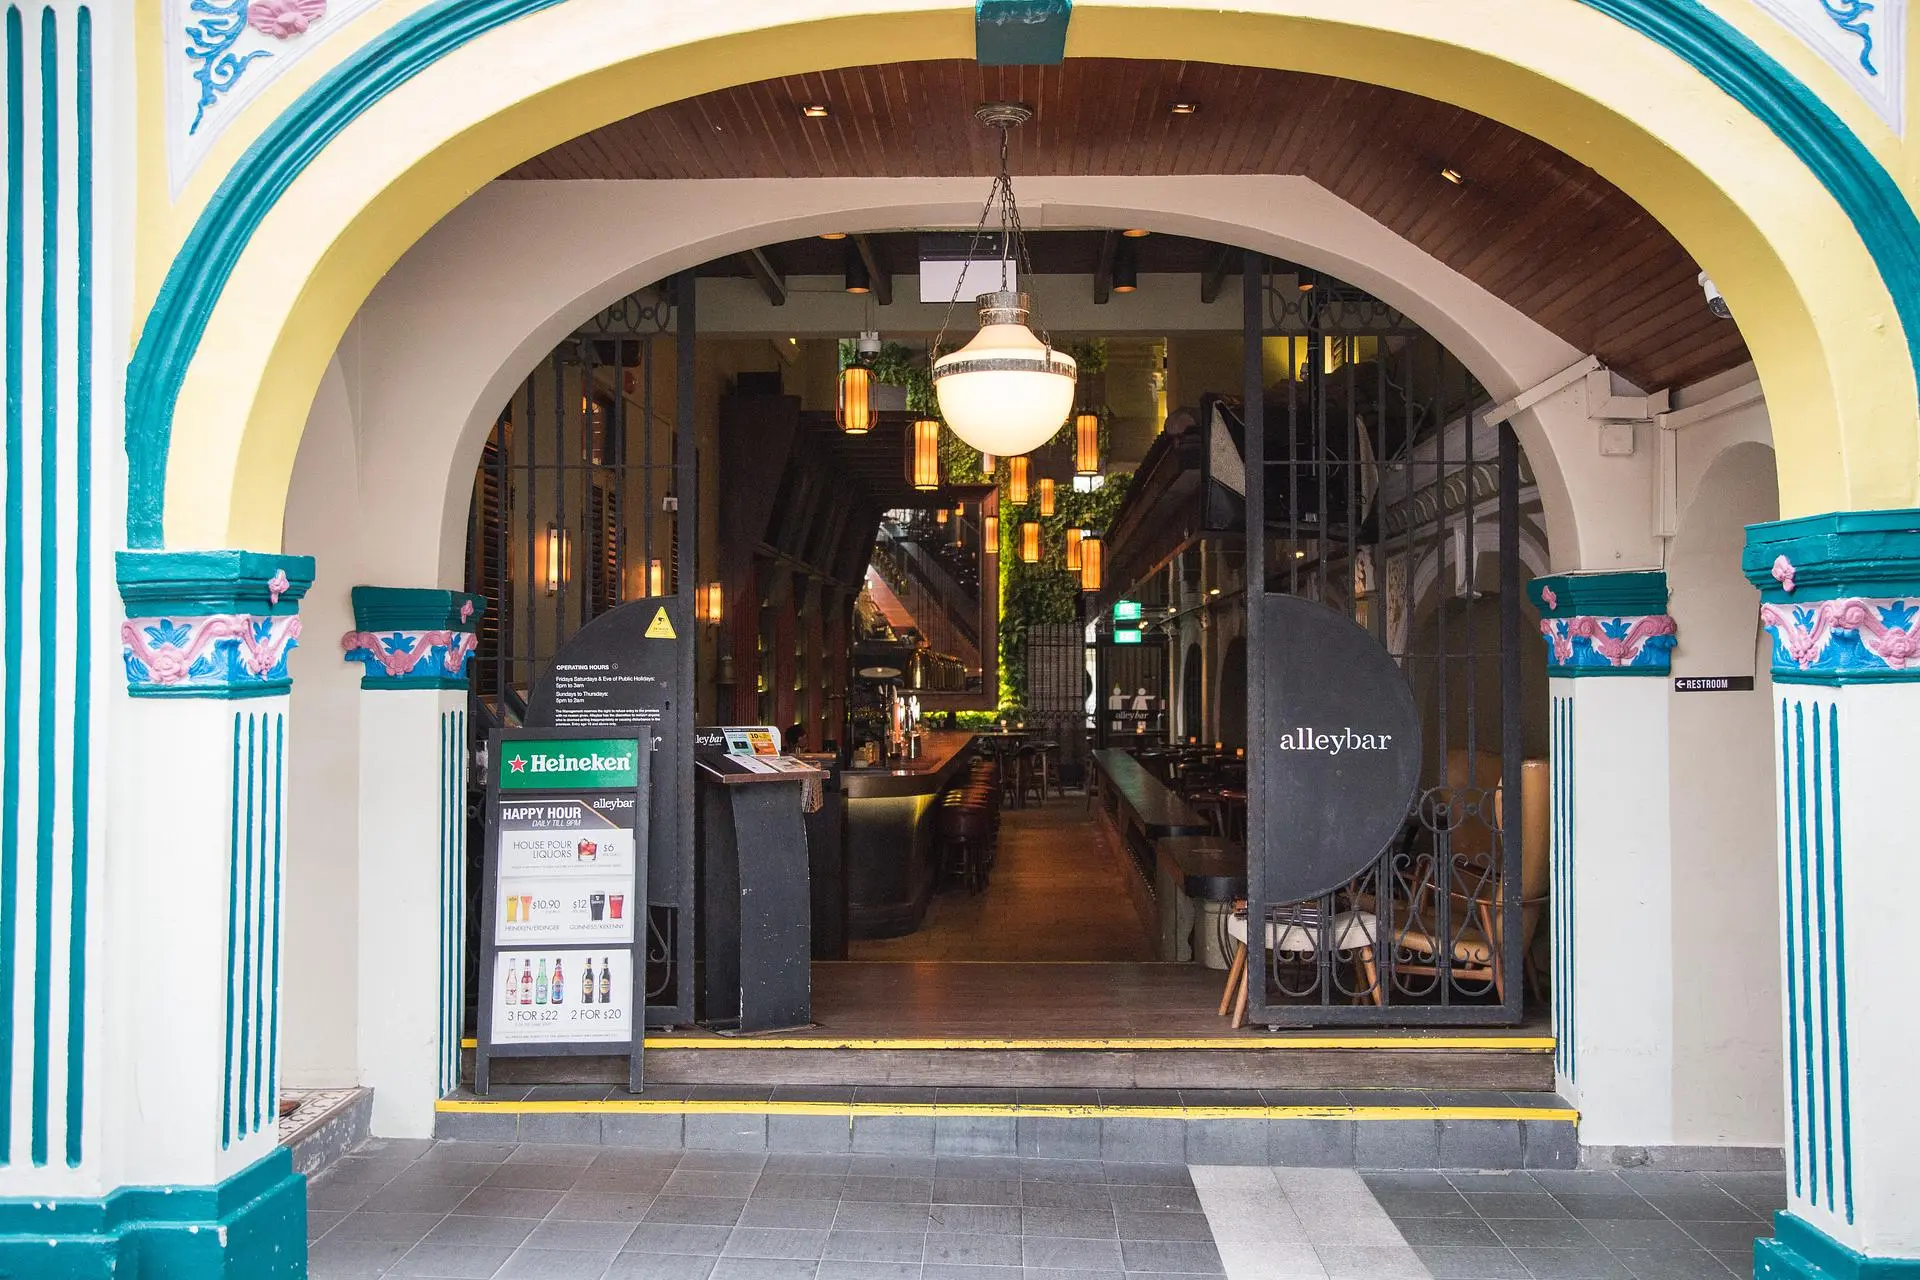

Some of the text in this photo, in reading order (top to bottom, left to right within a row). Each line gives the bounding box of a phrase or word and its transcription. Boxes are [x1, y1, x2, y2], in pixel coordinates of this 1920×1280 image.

[1686, 679, 1728, 689] RESTROOM
[696, 733, 724, 746] leybar
[1280, 727, 1392, 755] alleybar
[530, 753, 632, 772] Heineken
[593, 798, 635, 811] alleybar
[503, 807, 582, 820] HAPPY HOUR
[532, 820, 551, 828] DAILY
[513, 840, 572, 850] HOUSE POUR
[603, 843, 614, 852] $6
[533, 850, 572, 859] LIQUORS
[532, 900, 561, 910] $10.90
[573, 899, 587, 909] $12
[508, 1010, 558, 1021] 3 FOR $22
[570, 1009, 621, 1020] 2 FOR $20
